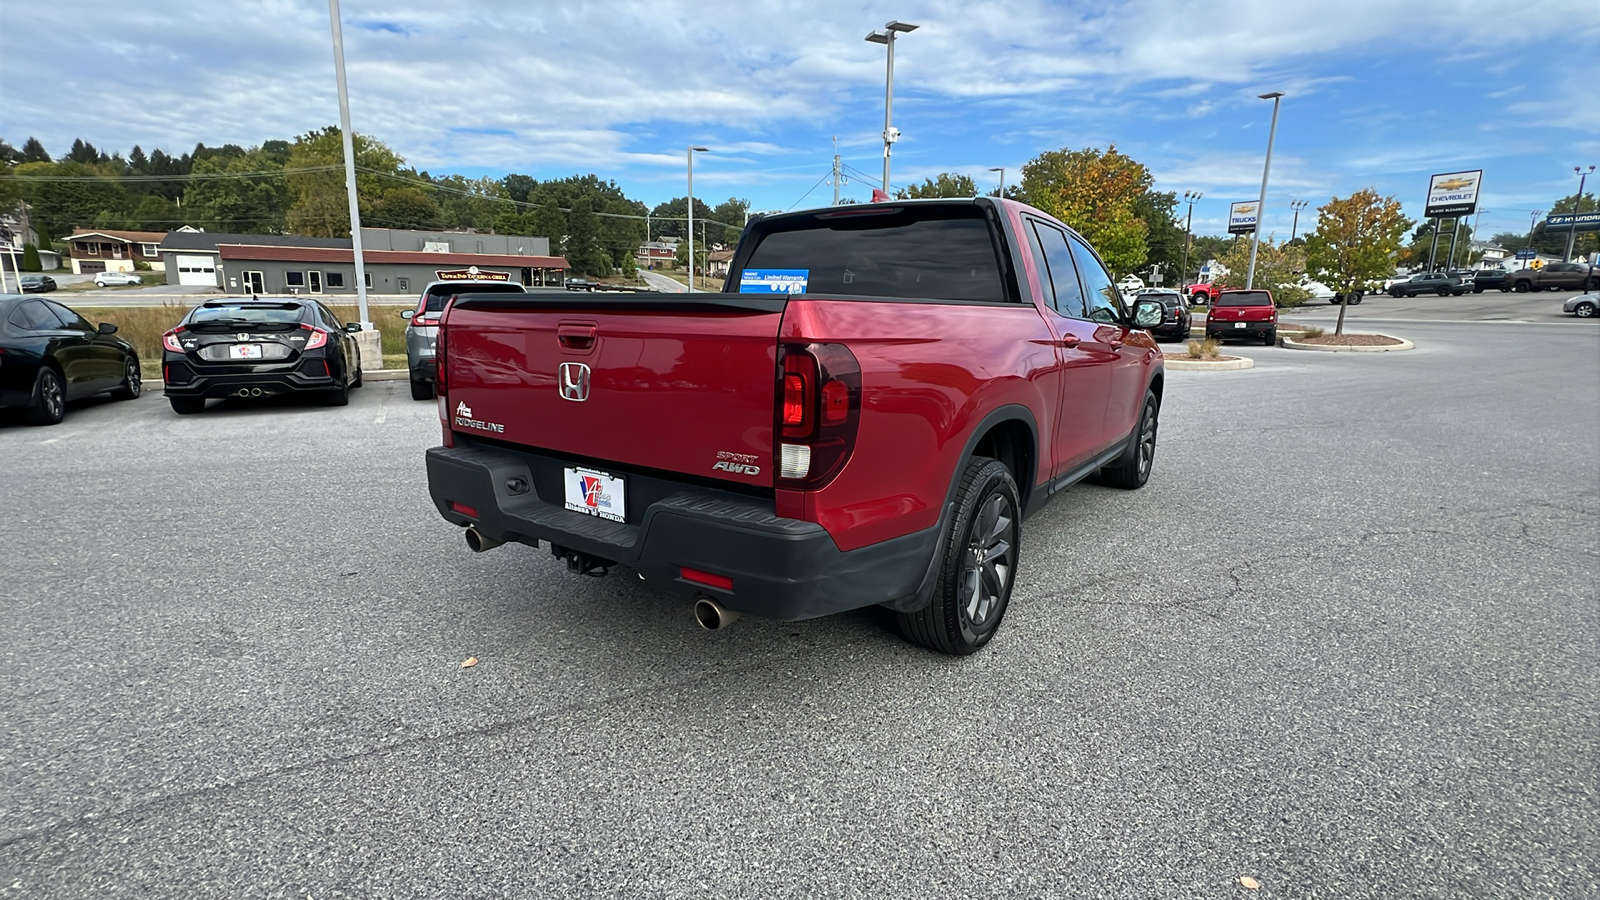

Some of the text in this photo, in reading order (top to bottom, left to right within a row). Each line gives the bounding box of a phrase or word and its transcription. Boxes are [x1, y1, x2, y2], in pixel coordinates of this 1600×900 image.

[1431, 193, 1473, 202] CHEVROLET
[455, 416, 505, 433] RIDGELINE
[716, 450, 759, 463] SPORT
[712, 461, 760, 476] AWD
[599, 510, 626, 523] HONDA
